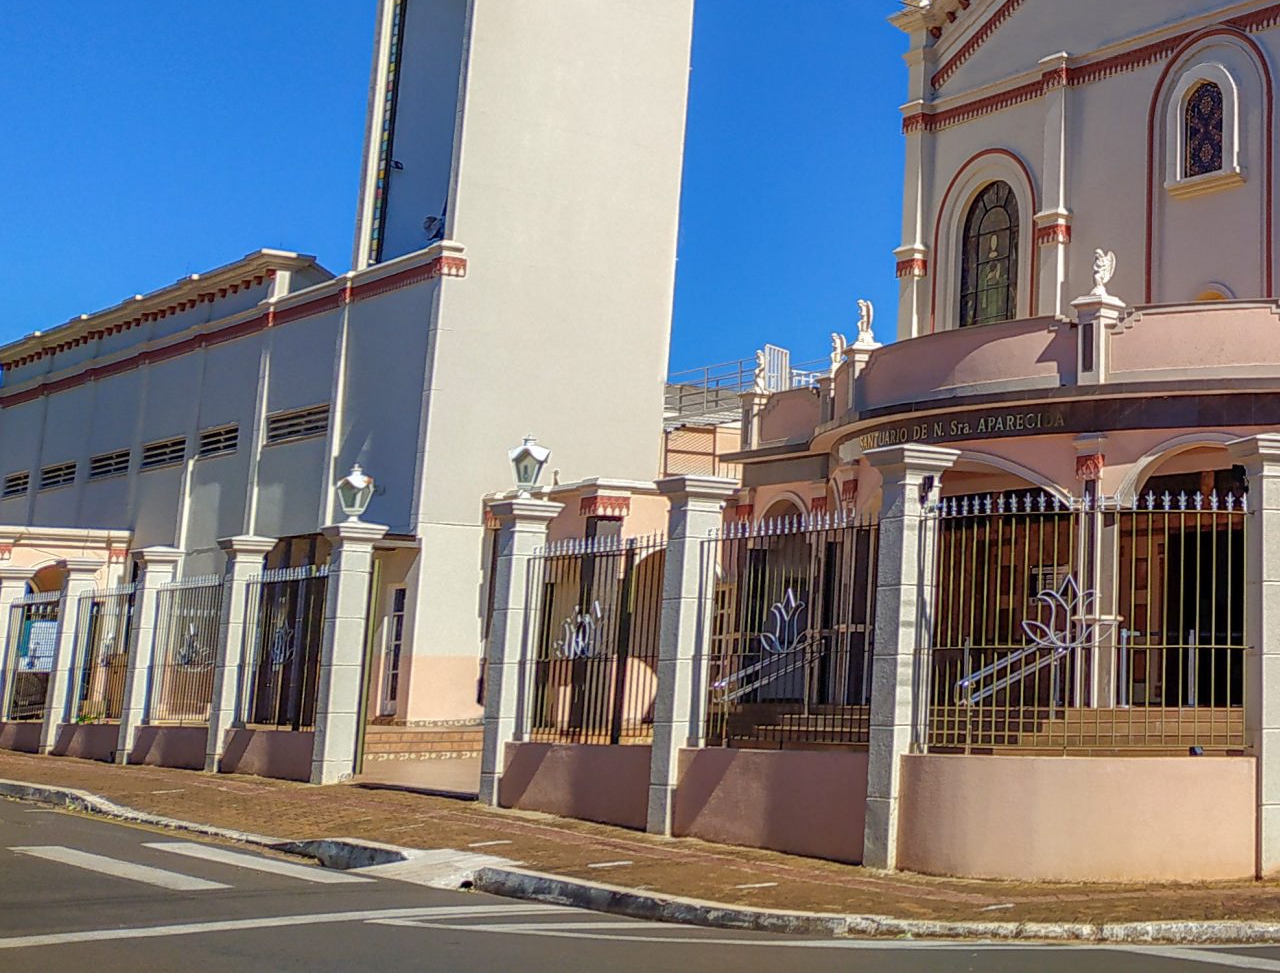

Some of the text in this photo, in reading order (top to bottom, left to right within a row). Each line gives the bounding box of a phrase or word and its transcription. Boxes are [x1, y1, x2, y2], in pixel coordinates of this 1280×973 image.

[913, 424, 928, 440] DE
[933, 422, 945, 437] N.
[950, 420, 973, 435] Sra.
[977, 412, 1065, 433] APARECIDA
